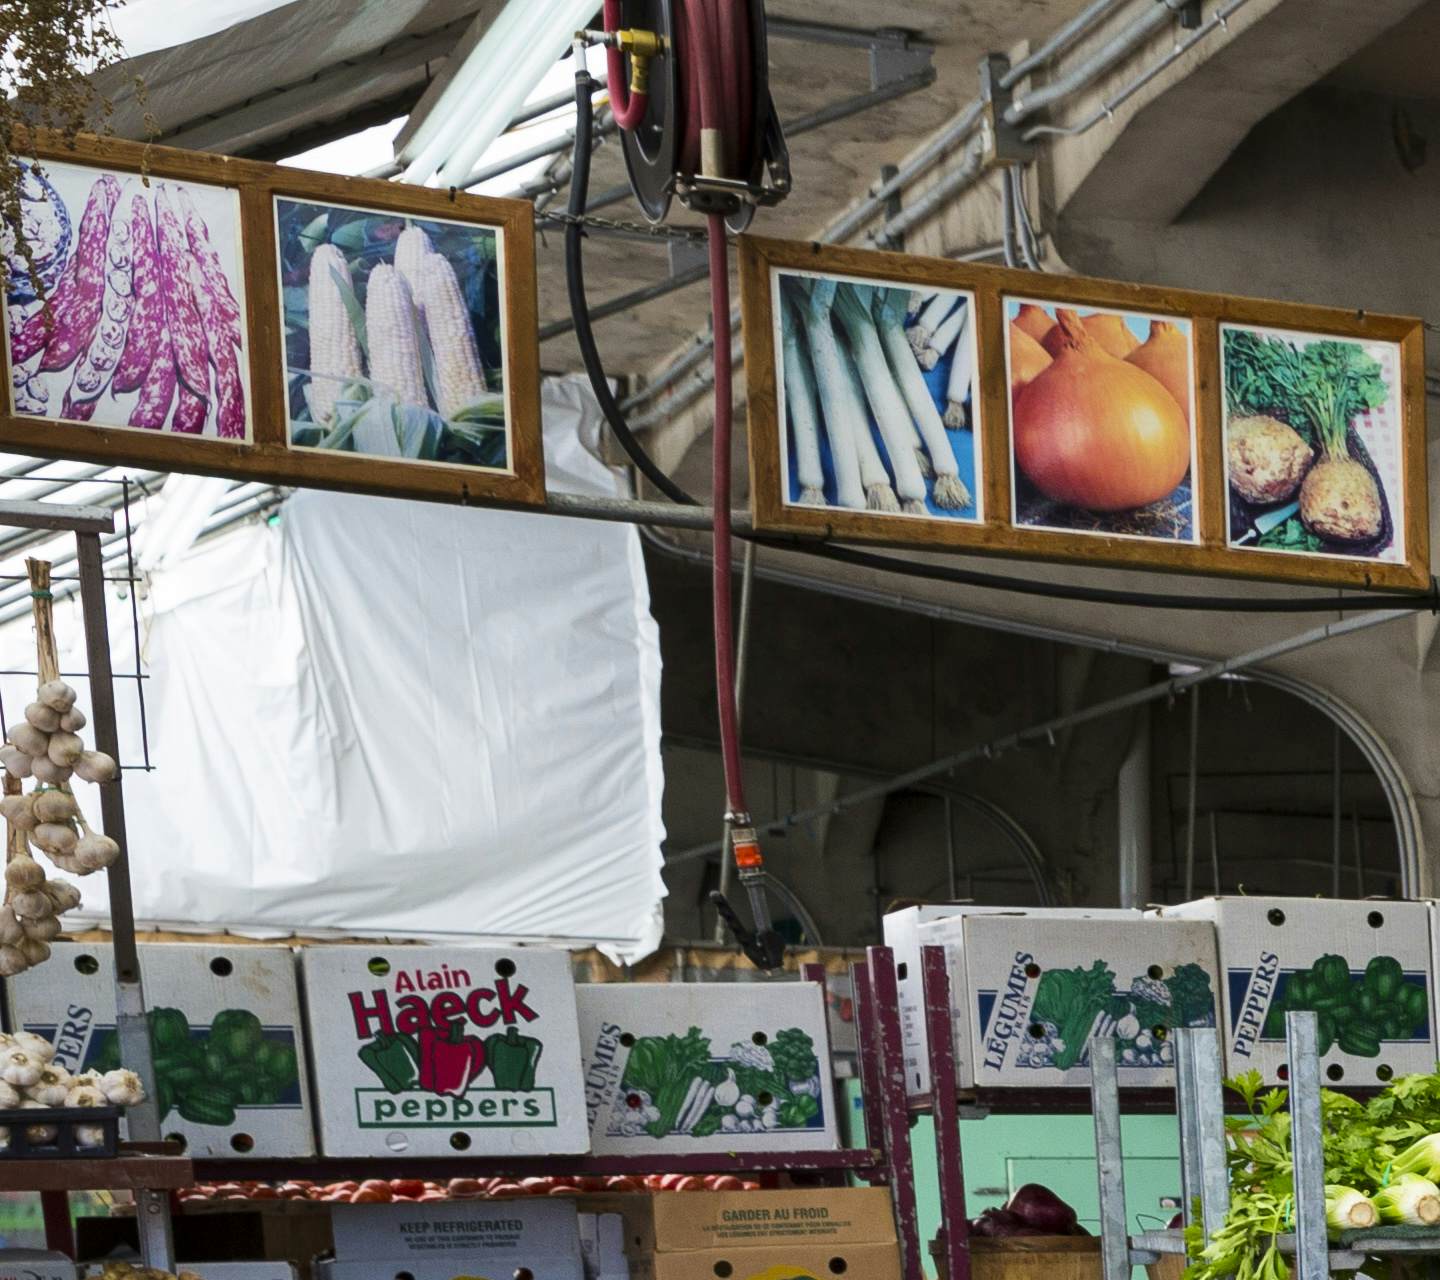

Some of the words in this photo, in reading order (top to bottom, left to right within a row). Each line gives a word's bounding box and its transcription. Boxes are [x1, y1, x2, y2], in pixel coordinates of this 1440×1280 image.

[395, 964, 472, 993] Alain
[347, 978, 541, 1040] Haeck
[1233, 951, 1279, 1057] PEPPERS
[374, 1095, 542, 1121] peppers
[400, 1221, 431, 1234] KEEP
[433, 1219, 524, 1233] REFRIGERATED
[722, 1208, 771, 1222] GARDER
[773, 1207, 789, 1220] AU
[793, 1206, 829, 1219] FROID
